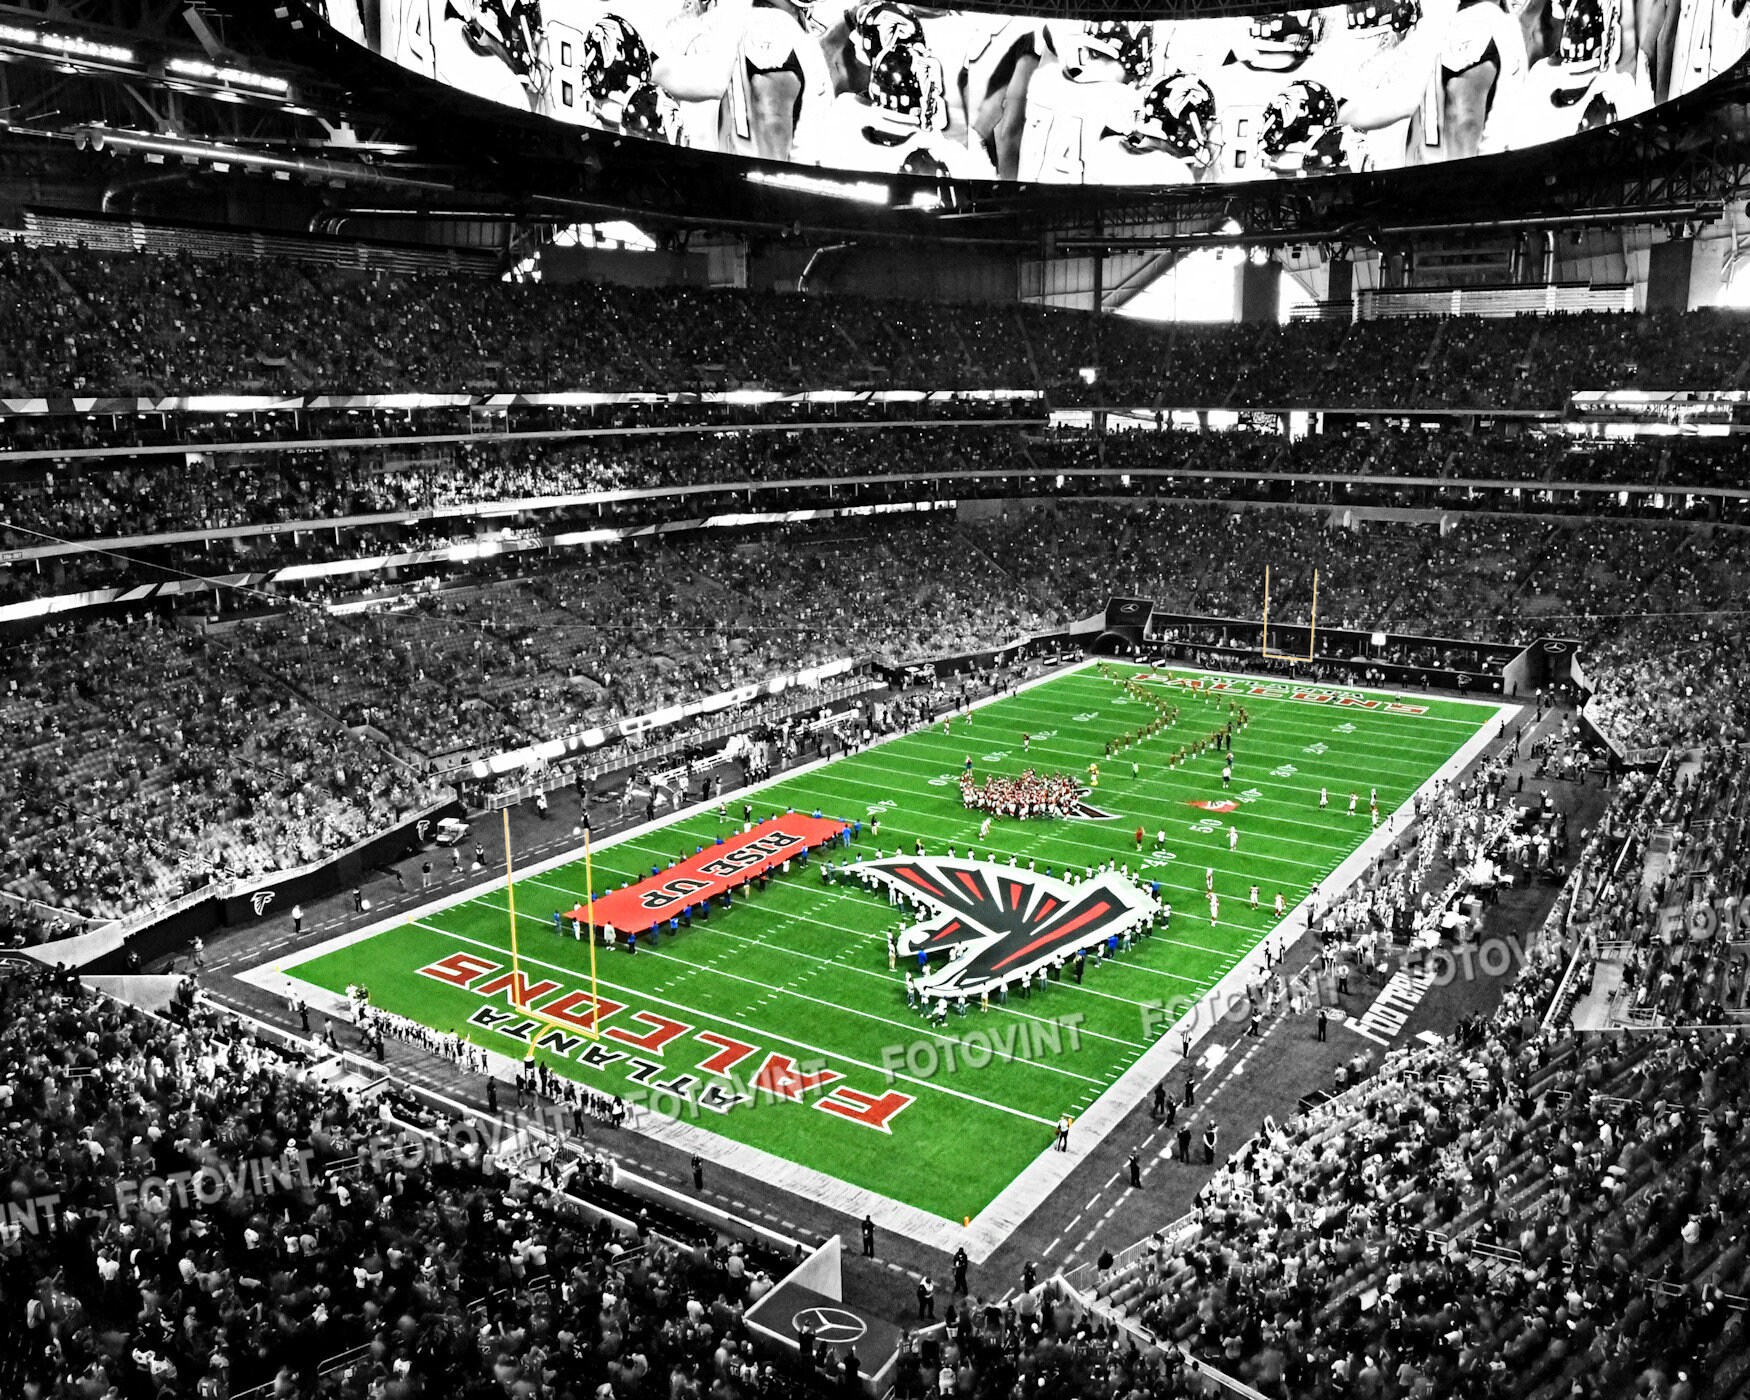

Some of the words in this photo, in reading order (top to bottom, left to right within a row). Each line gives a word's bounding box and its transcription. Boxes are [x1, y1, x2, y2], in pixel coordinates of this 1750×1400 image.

[1130, 672, 1430, 715] FALCONS
[1199, 675, 1365, 700] ATLANTA
[1189, 819, 1223, 834] 50
[698, 830, 806, 878] RISE
[1142, 851, 1177, 868] 40
[640, 877, 713, 910] UP
[1343, 969, 1438, 1047] FOOTBALL
[414, 951, 918, 1135] FALCONS
[466, 1005, 753, 1116] ATLANTA
[482, 1211, 494, 1223] 22
